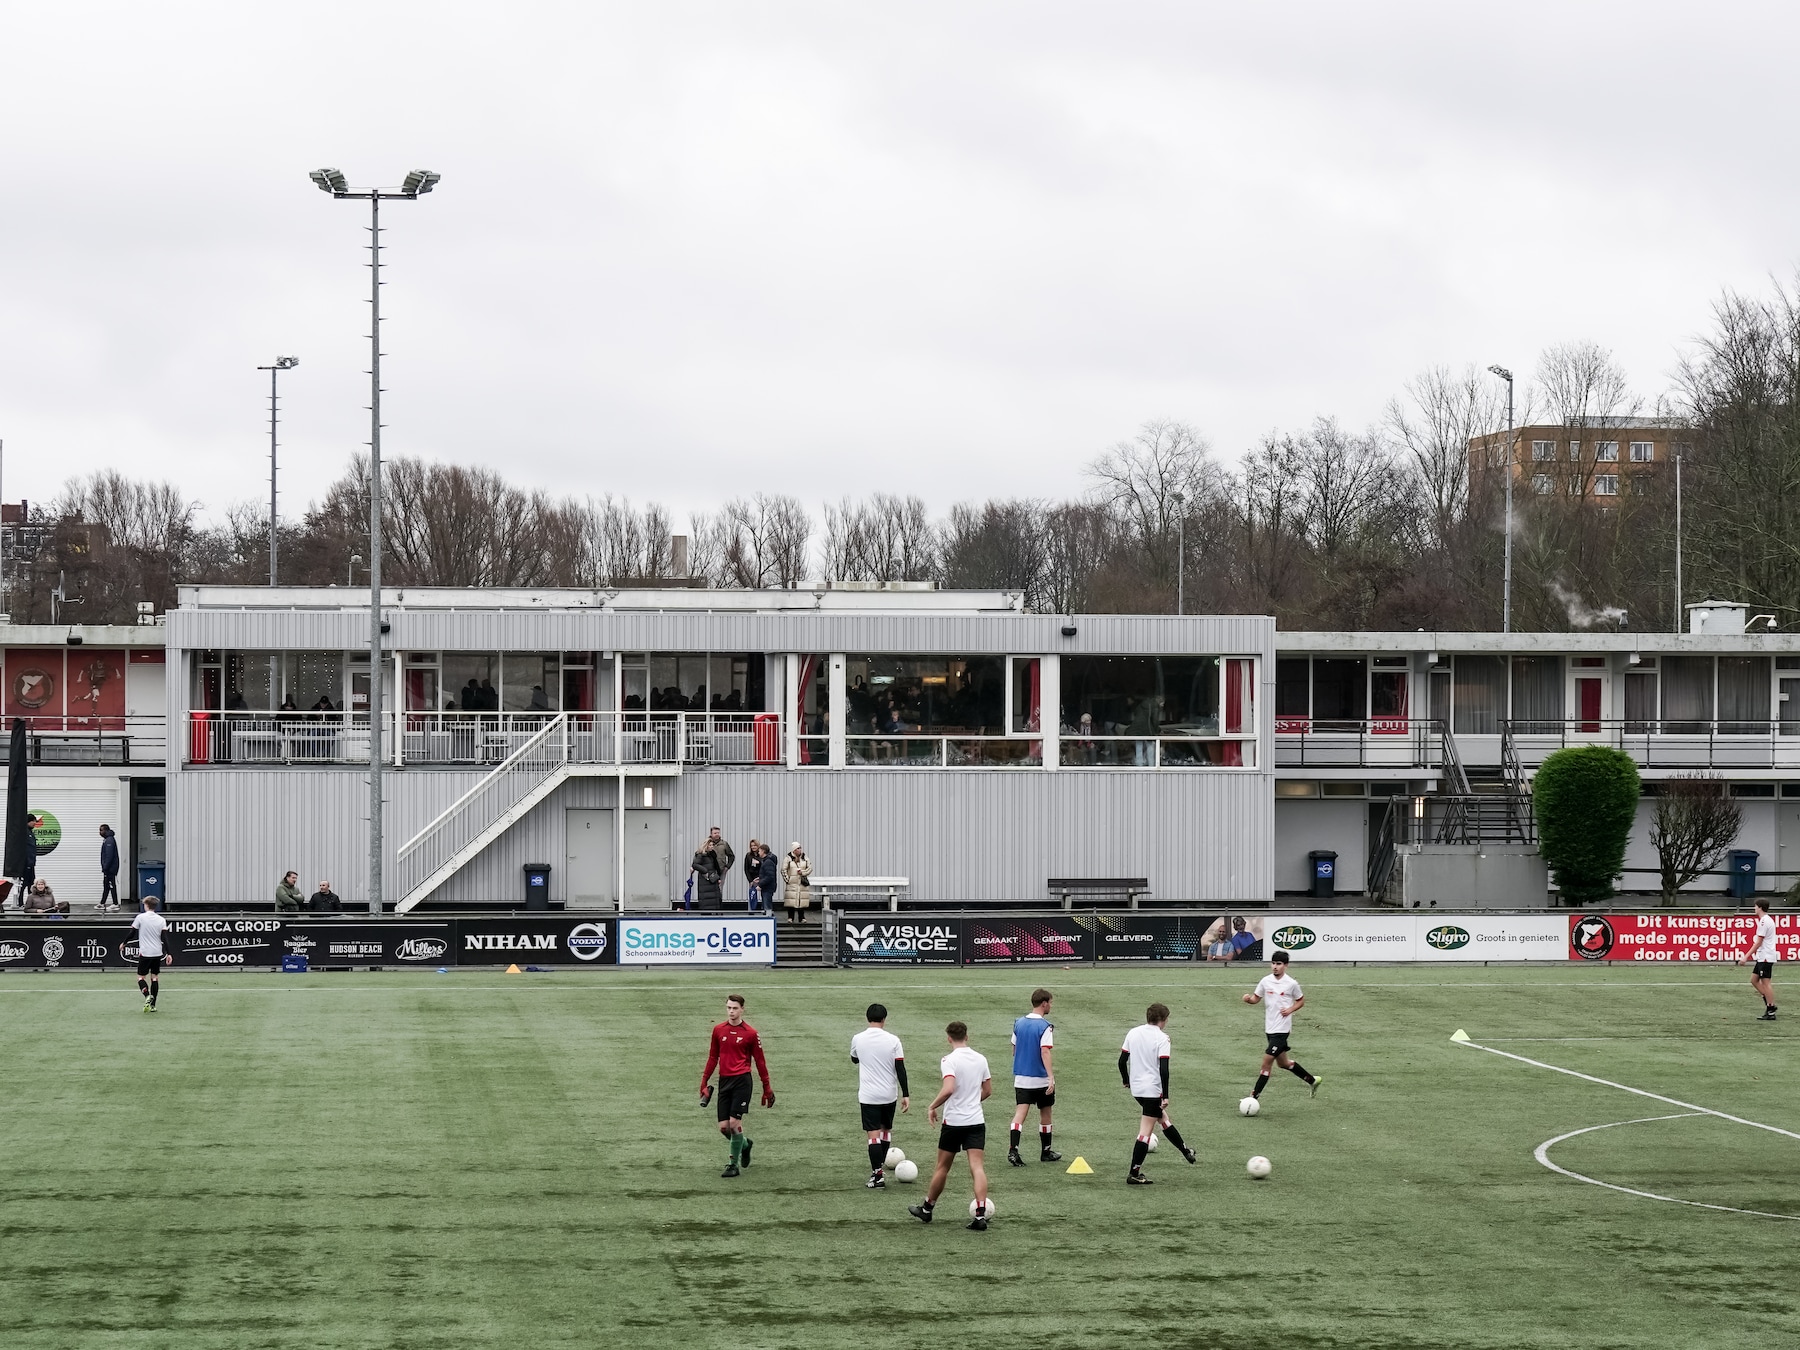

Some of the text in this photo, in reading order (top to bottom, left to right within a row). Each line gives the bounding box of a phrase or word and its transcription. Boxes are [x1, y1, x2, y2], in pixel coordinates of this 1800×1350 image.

[586, 822, 591, 830] C
[644, 822, 649, 830] A
[176, 922, 232, 933] HORECA
[234, 921, 281, 932] GROEP
[1636, 915, 1662, 928] Dit
[1667, 915, 1790, 931] kunstgrasld
[880, 925, 957, 938] VISUAL
[186, 937, 262, 946] SEAFOOD BAR 19
[464, 934, 558, 950] NIHAM
[625, 927, 770, 949] Sansa-clean
[973, 936, 1019, 945] GEMAAKT
[1042, 935, 1082, 943] GEPRINT
[1105, 934, 1154, 942] GELEVERD
[1273, 929, 1316, 948] Sligro
[1322, 933, 1407, 944] Groots in genieten
[1427, 929, 1470, 948] Sligro
[1476, 933, 1560, 944] Groots in genieten
[1619, 931, 1668, 944] mede
[1672, 931, 1748, 948] mogelijk
[0, 944, 26, 957] llers
[329, 944, 383, 954] HUDSON BEACH
[398, 938, 445, 958] Millers
[880, 938, 949, 951] VOICE
[77, 945, 108, 960] TIJD
[625, 949, 696, 958] Schoonmaakbedrijf
[1634, 948, 1674, 961] door
[1679, 948, 1700, 961] de
[1705, 948, 1746, 961] Club
[205, 954, 245, 964] CLOOS
